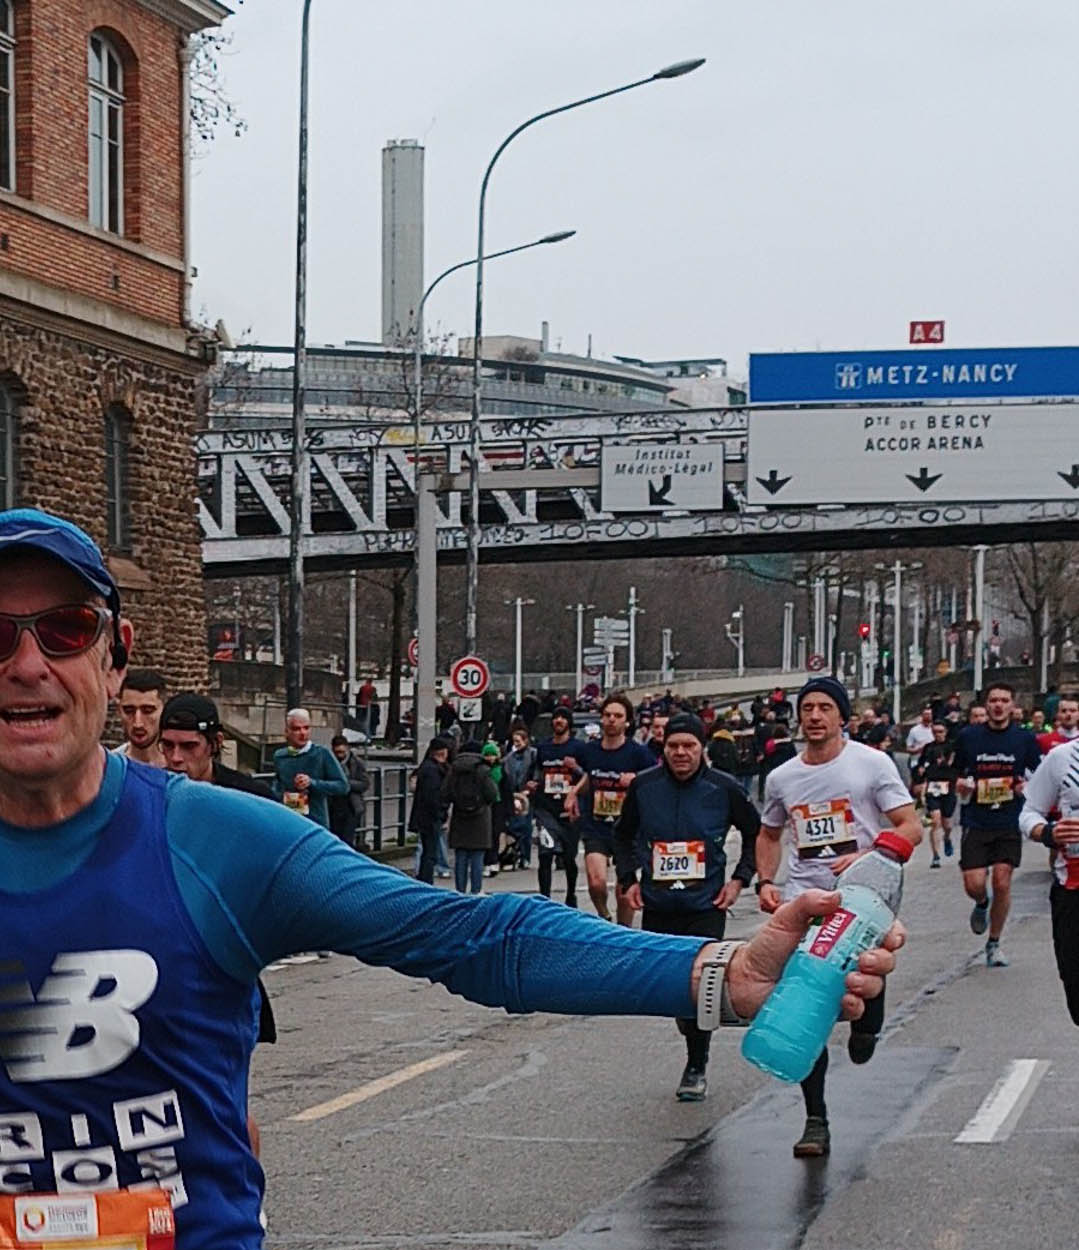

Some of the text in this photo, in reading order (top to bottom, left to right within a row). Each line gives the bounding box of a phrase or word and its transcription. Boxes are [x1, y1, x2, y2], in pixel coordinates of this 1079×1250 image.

[867, 363, 1017, 386] METZ-NANCY
[927, 415, 992, 430] BERCY
[864, 435, 984, 452] ACCOR ARENA
[635, 449, 691, 460] Institut
[459, 669, 482, 686] 30
[805, 816, 835, 836] 4321
[660, 856, 689, 872] 2620
